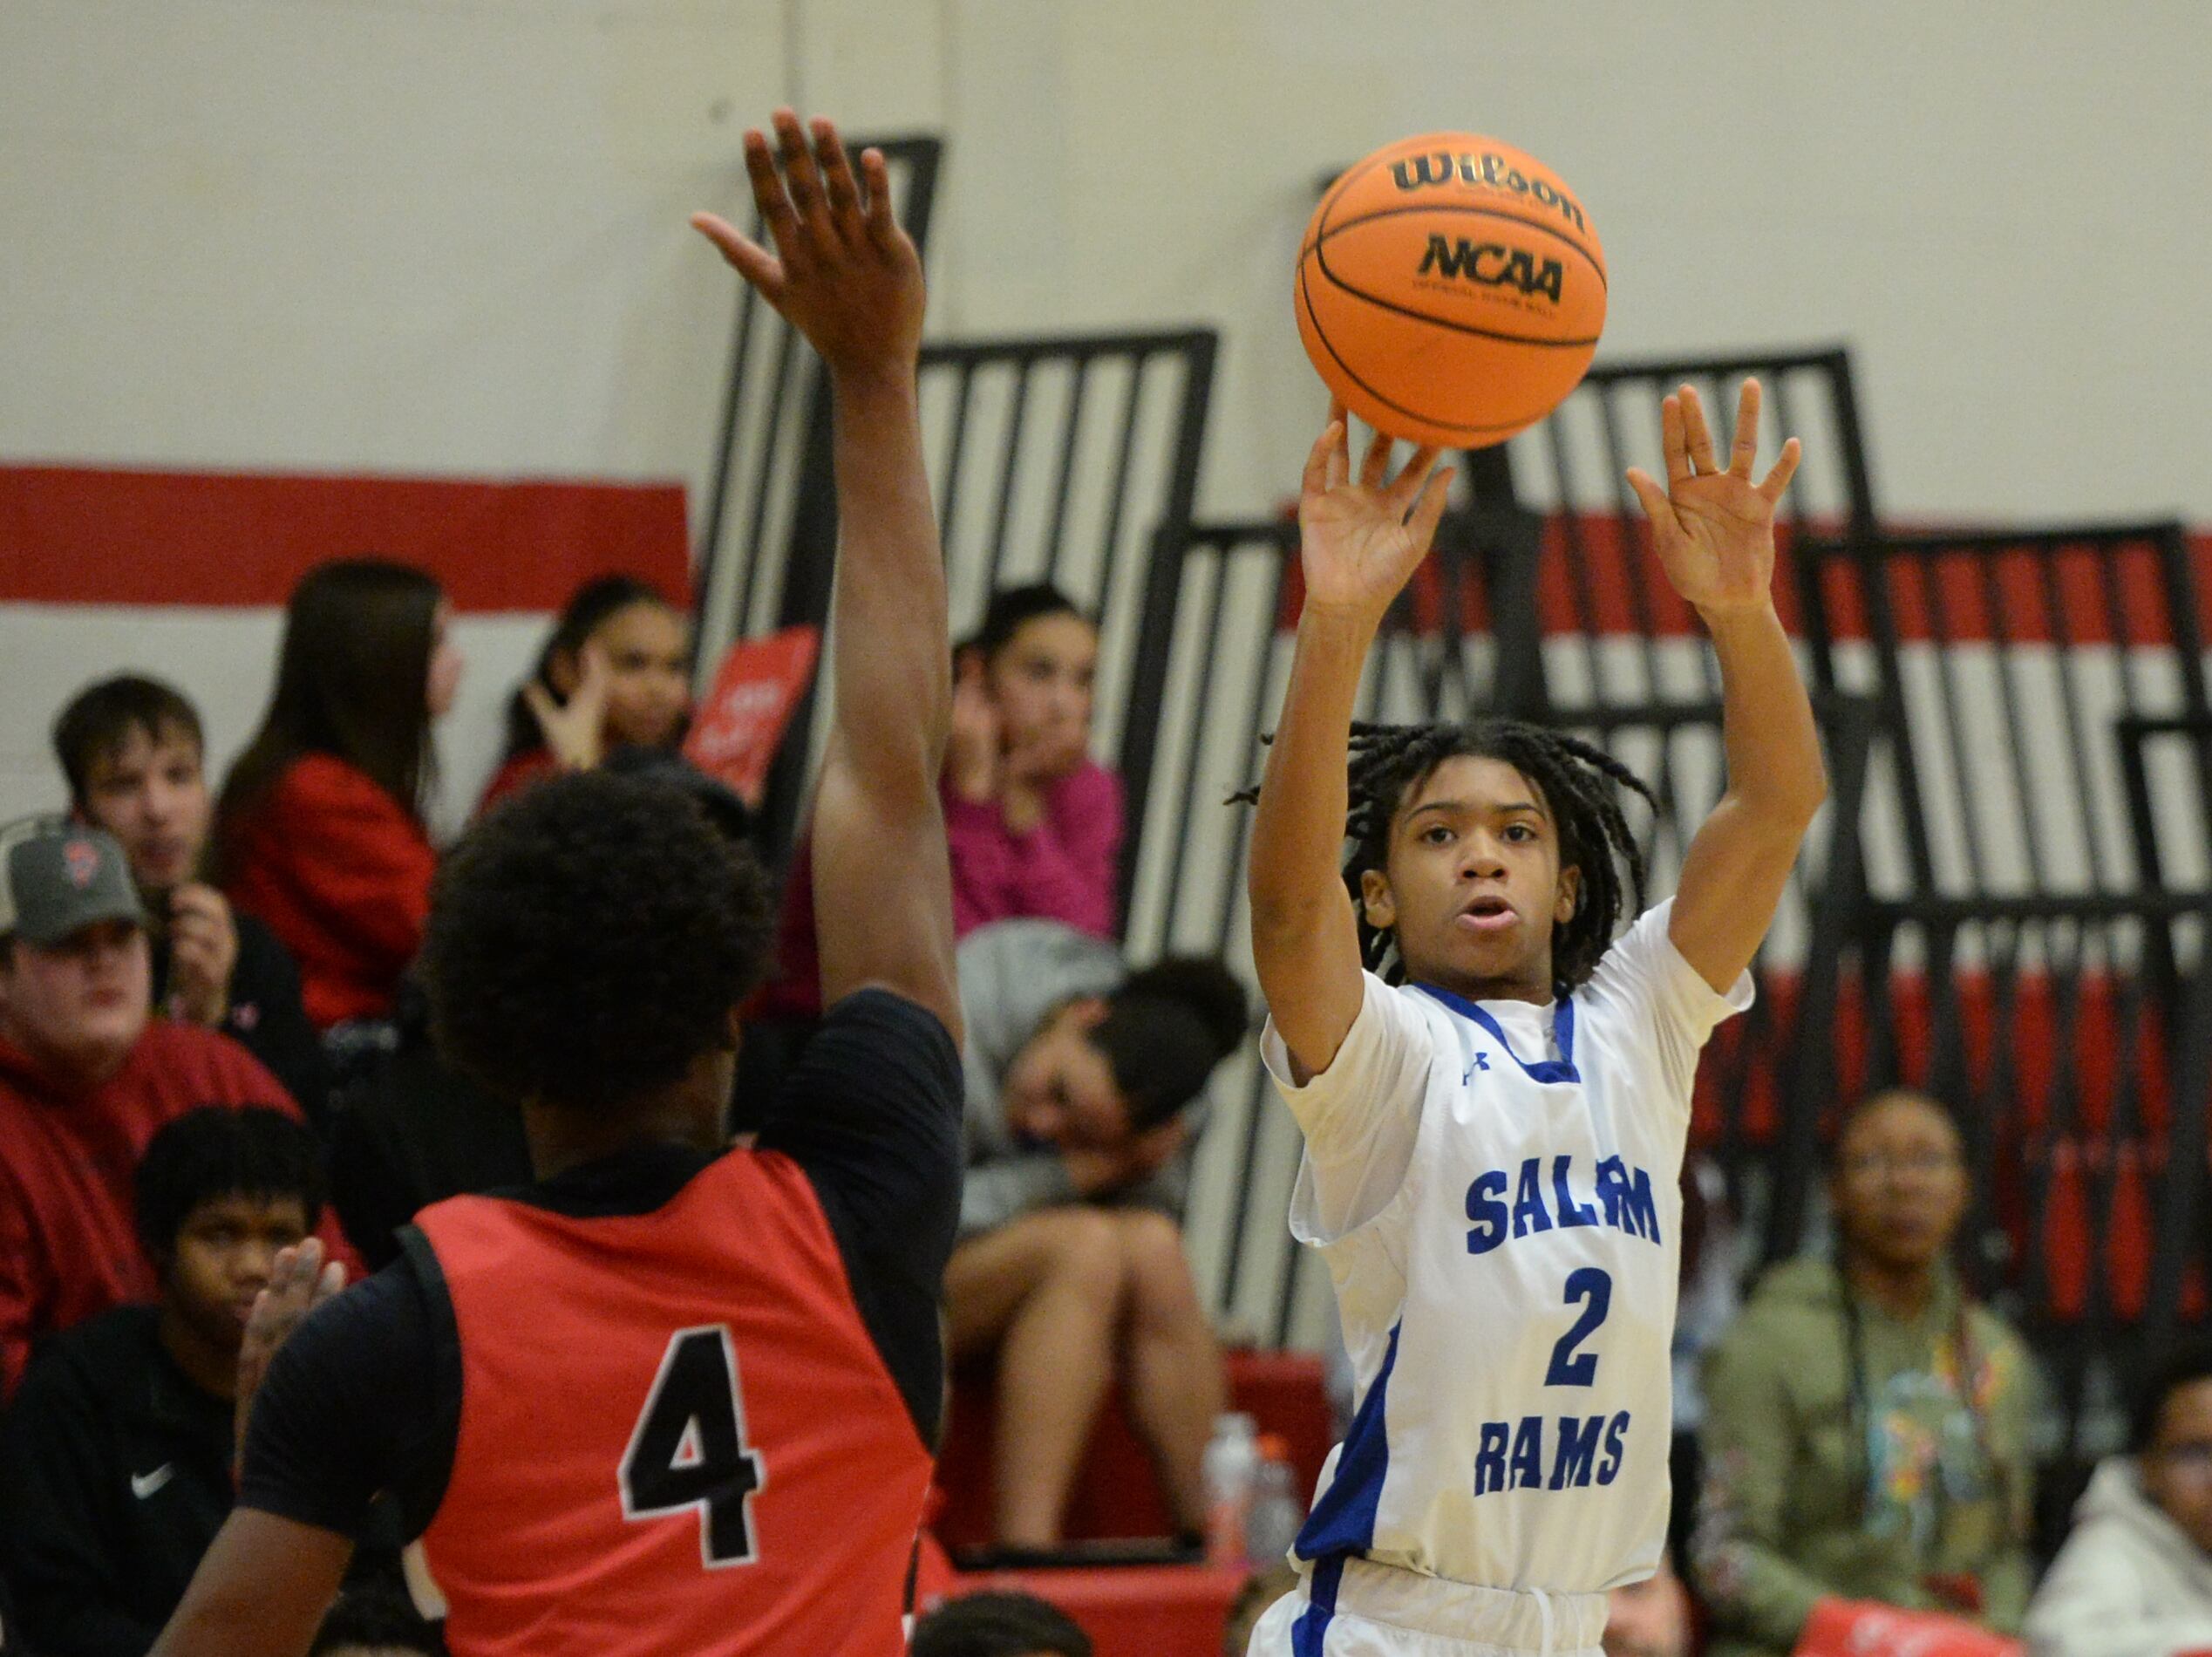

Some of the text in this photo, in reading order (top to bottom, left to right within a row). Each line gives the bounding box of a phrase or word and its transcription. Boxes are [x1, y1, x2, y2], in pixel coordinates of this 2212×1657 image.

[1389, 152, 1585, 234] Wilson
[1417, 233, 1562, 303] NCAA
[1544, 1267, 1612, 1387] 2
[616, 1323, 767, 1571] 4
[1474, 1410, 1630, 1497] RAMS
